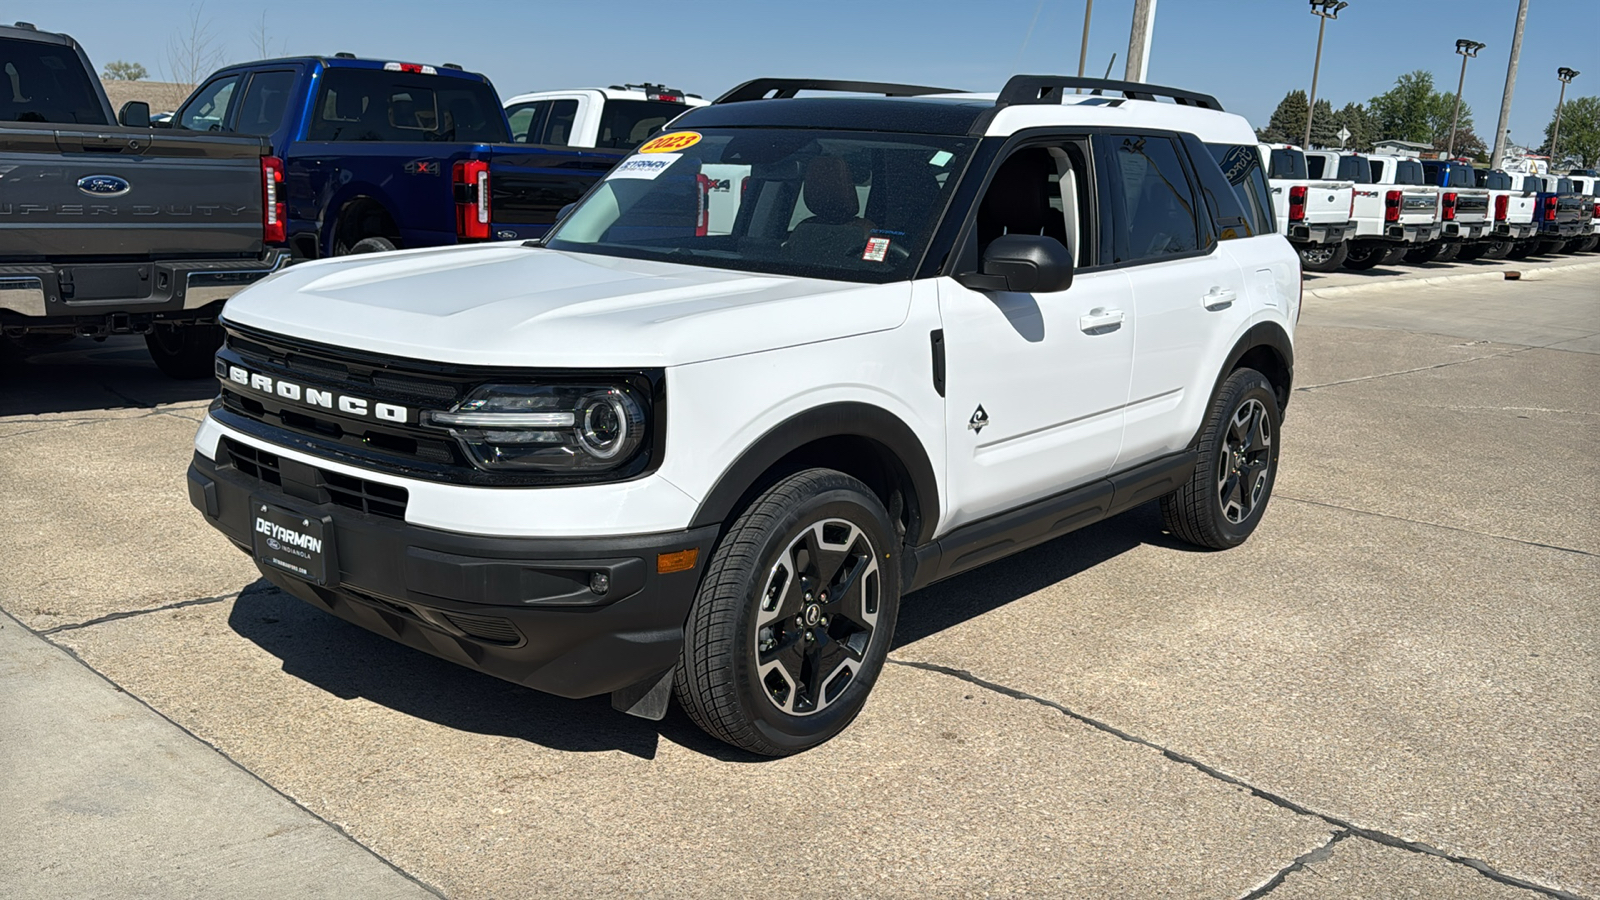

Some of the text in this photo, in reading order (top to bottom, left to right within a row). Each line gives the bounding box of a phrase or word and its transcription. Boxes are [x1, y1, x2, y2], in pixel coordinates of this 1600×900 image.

[643, 136, 698, 151] 2023
[707, 178, 731, 190] X4
[132, 204, 246, 216] DUTY
[229, 365, 408, 424] BRONCO
[255, 516, 322, 554] DEYARMAN
[281, 544, 312, 560] INDIANOLA
